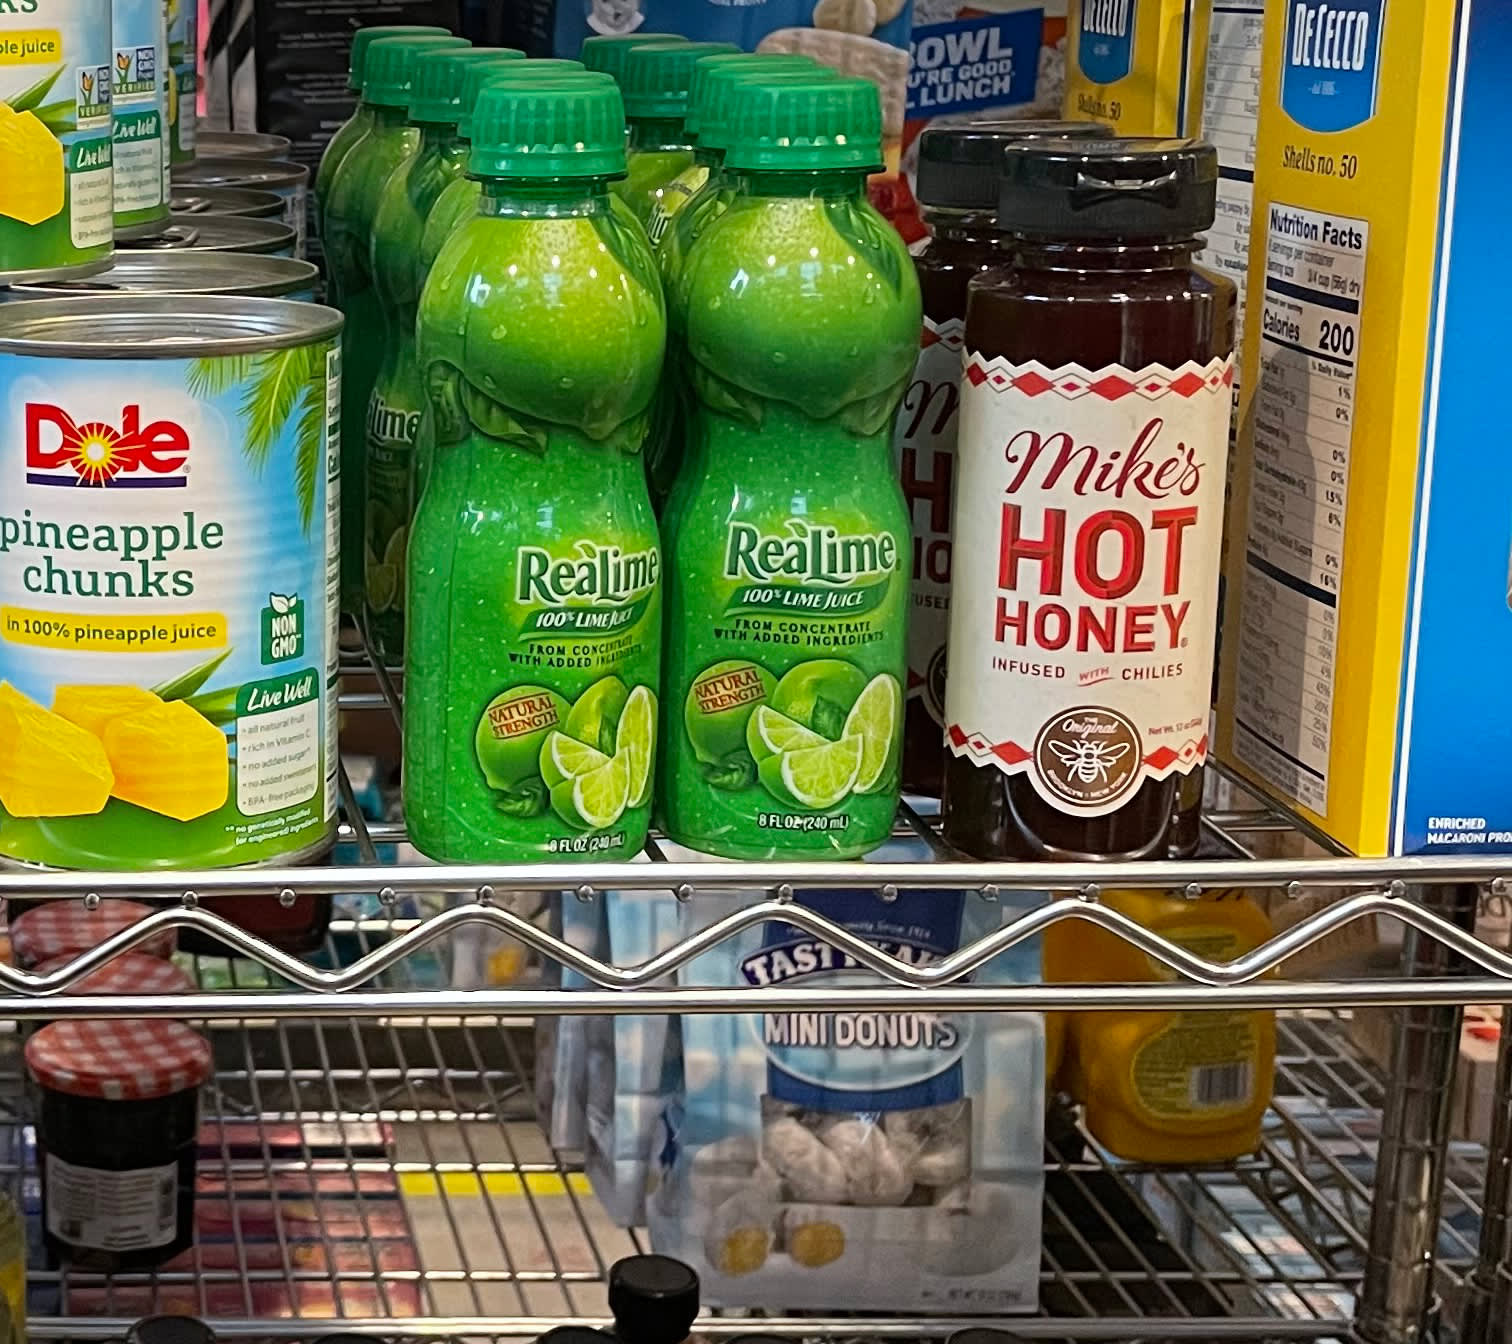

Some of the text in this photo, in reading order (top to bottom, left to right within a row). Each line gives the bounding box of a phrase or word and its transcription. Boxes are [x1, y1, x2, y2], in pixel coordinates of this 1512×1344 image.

[921, 76, 1011, 107] LUNCH
[1282, 144, 1357, 180] Shells no. 50
[1269, 207, 1363, 250] Nutrition Facts
[1262, 307, 1355, 355] Calories 200
[25, 402, 190, 484] Dole
[1004, 417, 1207, 500] Mike's
[0, 508, 224, 562] pineapple
[724, 519, 896, 584] ReaLime
[997, 501, 1199, 600] HOT
[23, 555, 195, 598] chunks
[515, 540, 659, 606] ReaLime
[741, 589, 865, 612] 100% LIME JUICE
[271, 613, 298, 636] NON
[714, 628, 885, 647] WITH ADDED INGREDIENTS
[735, 618, 871, 634] FROM CONCENTRATE
[993, 596, 1192, 654] HONEY
[271, 636, 298, 658] GMO
[695, 670, 762, 698] NATURAL
[992, 656, 1184, 682] INFUSED WITH CHILIES
[698, 683, 766, 714] STRENGTH
[1062, 718, 1119, 735] Original
[1426, 831, 1487, 845] MACARONI
[1427, 817, 1487, 831] ENRICHED
[764, 1012, 958, 1048] MINI DONUTS
